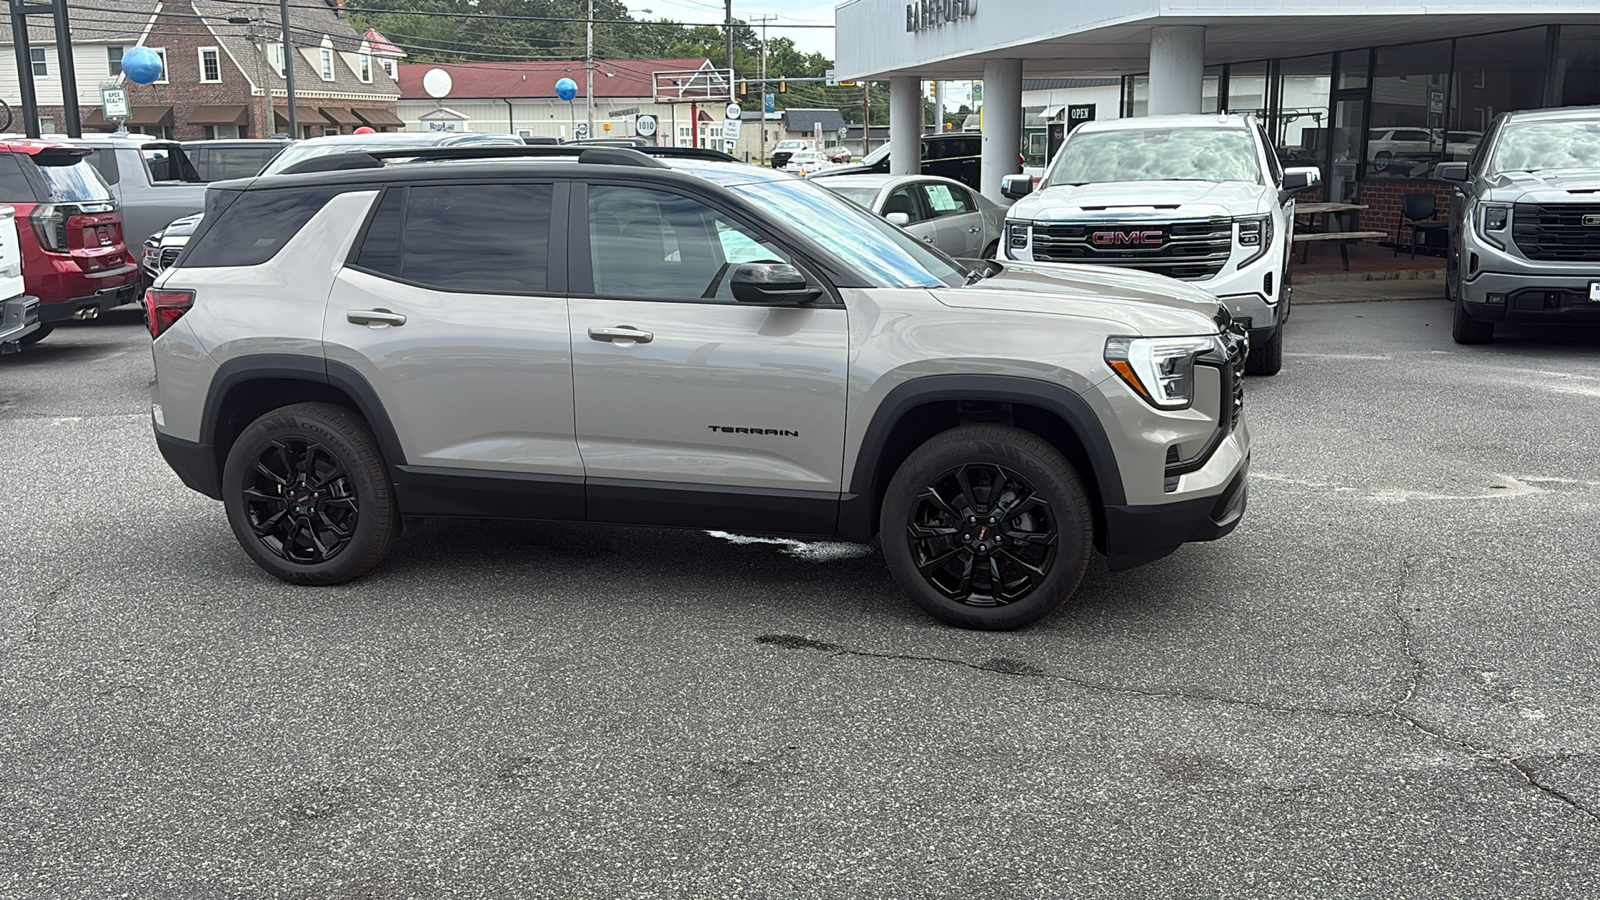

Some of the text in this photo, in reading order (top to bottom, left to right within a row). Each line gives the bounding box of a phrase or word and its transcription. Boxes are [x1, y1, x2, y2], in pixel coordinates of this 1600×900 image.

[907, 0, 978, 32] BAREFORD
[1071, 107, 1090, 119] OPEN
[639, 121, 654, 130] 1010
[1092, 230, 1163, 244] GMC
[707, 425, 799, 437] TERRAIN
